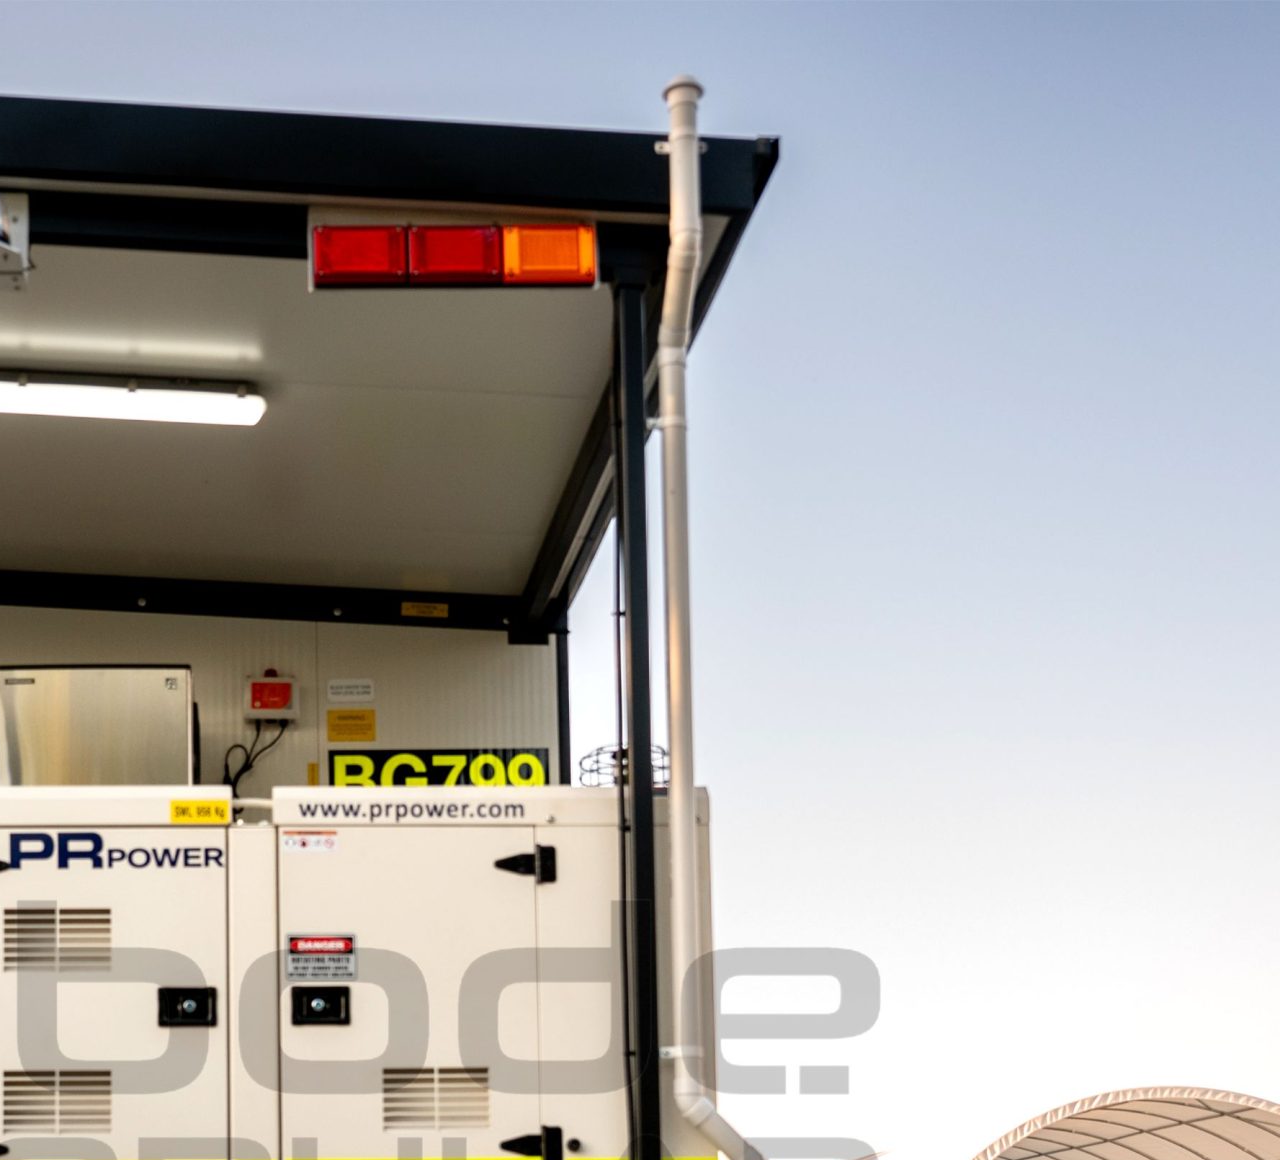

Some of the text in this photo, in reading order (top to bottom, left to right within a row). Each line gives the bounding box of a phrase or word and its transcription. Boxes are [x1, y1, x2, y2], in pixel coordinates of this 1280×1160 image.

[299, 802, 525, 822] www.prpower.com
[10, 833, 224, 869] PR POWER
[297, 940, 345, 951] DANGER
